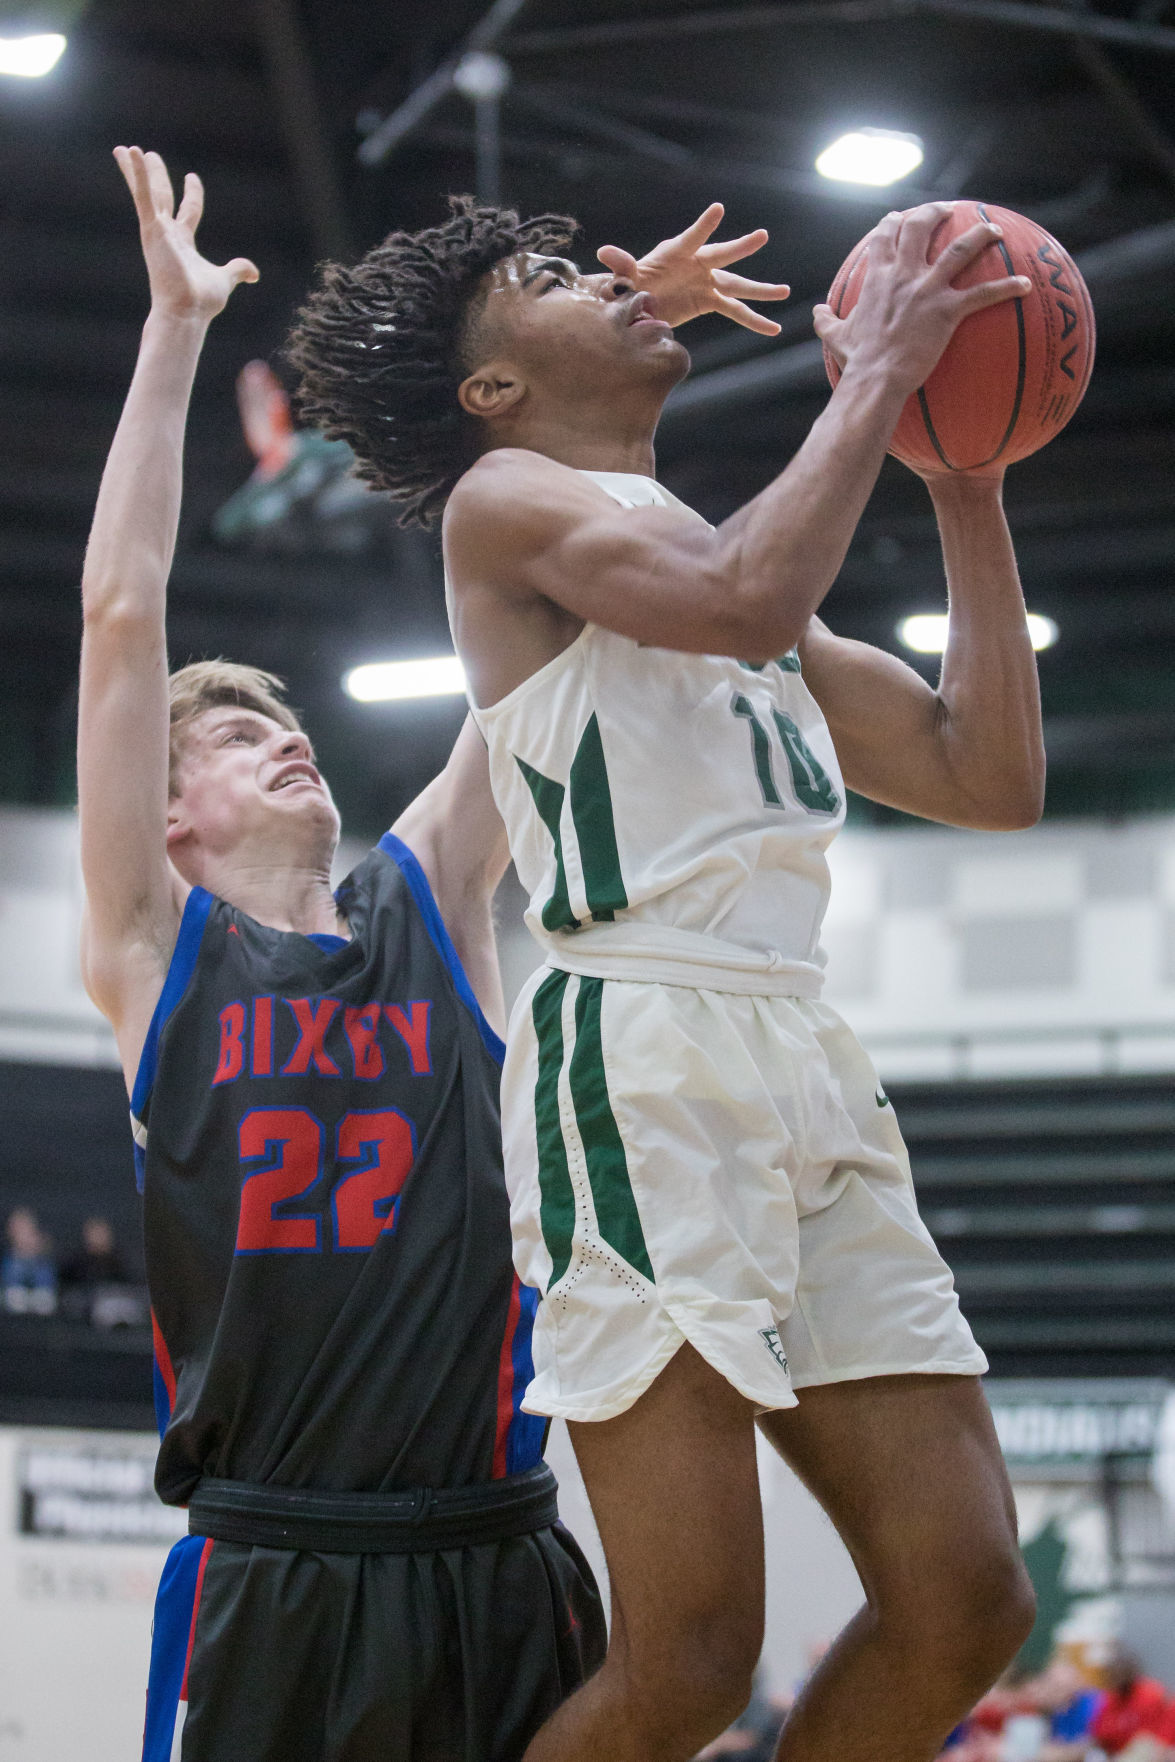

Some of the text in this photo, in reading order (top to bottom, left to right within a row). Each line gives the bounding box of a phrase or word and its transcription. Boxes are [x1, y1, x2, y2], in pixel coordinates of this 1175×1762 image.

[730, 689, 843, 818] 10
[210, 993, 434, 1089] BIXBY
[233, 1104, 418, 1257] 22
